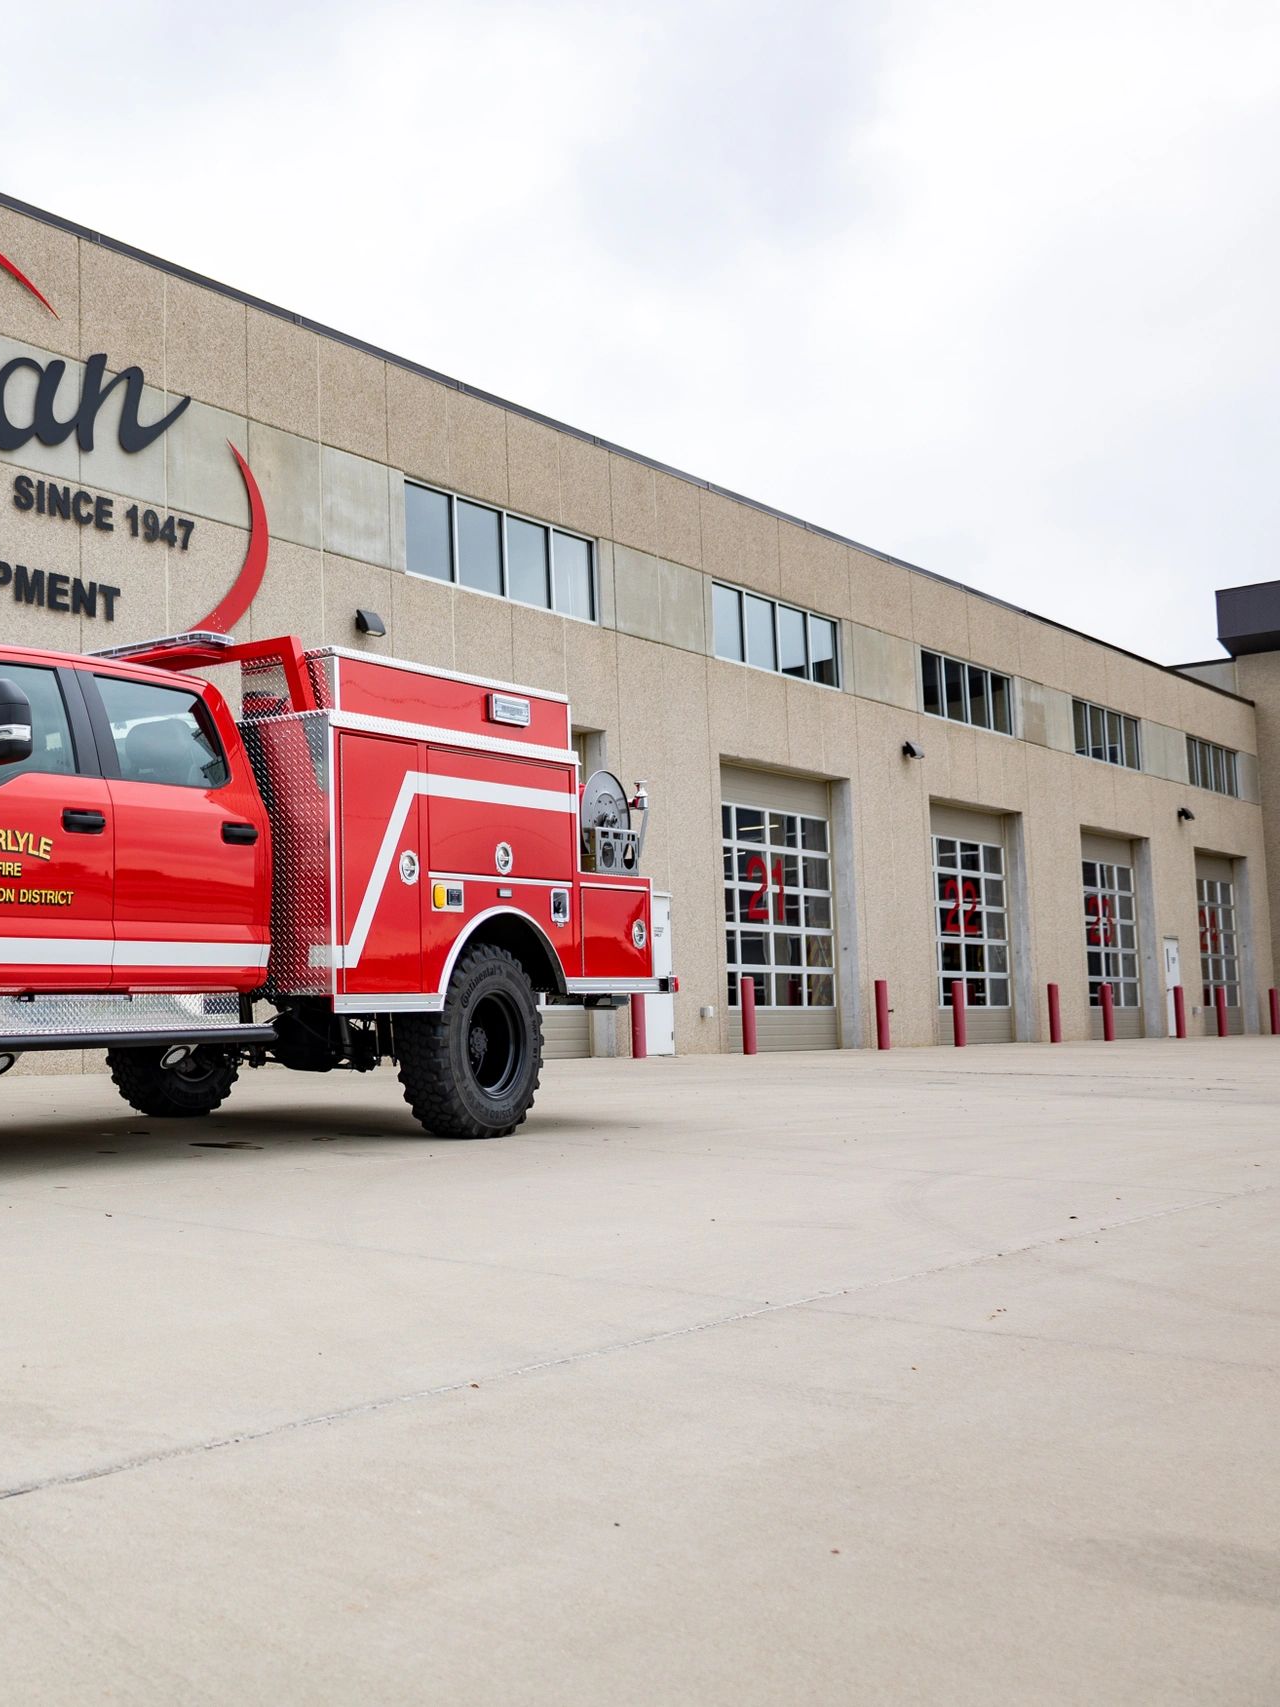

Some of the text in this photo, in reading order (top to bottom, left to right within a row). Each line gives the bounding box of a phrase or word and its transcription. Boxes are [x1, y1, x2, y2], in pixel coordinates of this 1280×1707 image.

[13, 474, 195, 551] SINCE 1947
[19, 888, 74, 906] DISTRICT
[746, 855, 785, 922] 21
[944, 879, 979, 935] 22
[460, 963, 497, 1009] Continental
